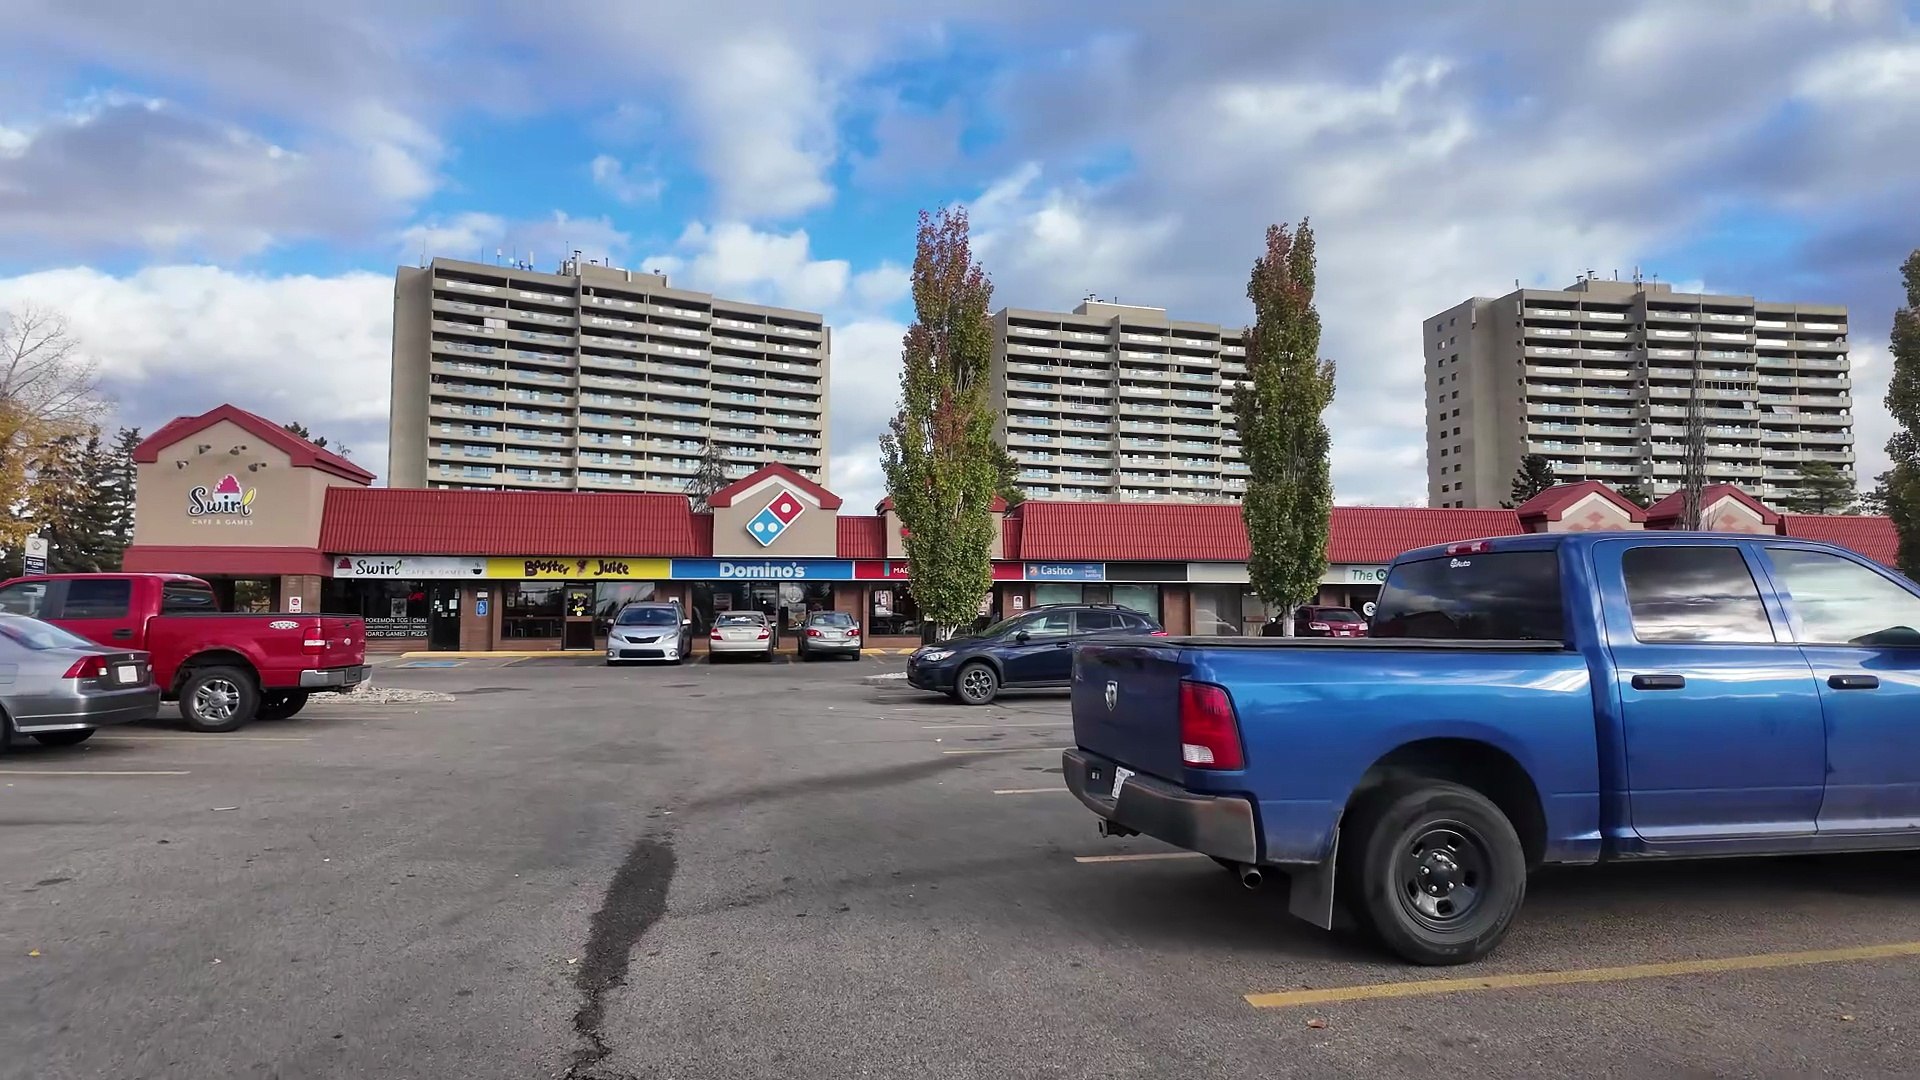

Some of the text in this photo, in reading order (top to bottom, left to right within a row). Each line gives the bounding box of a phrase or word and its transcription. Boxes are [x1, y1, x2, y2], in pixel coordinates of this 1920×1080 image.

[189, 486, 256, 517] Swirl
[355, 559, 402, 575] Swirl
[524, 560, 629, 577] Booster Juice
[719, 561, 806, 578] Domino's
[1040, 565, 1074, 576] Cashco
[1352, 569, 1374, 581] The
